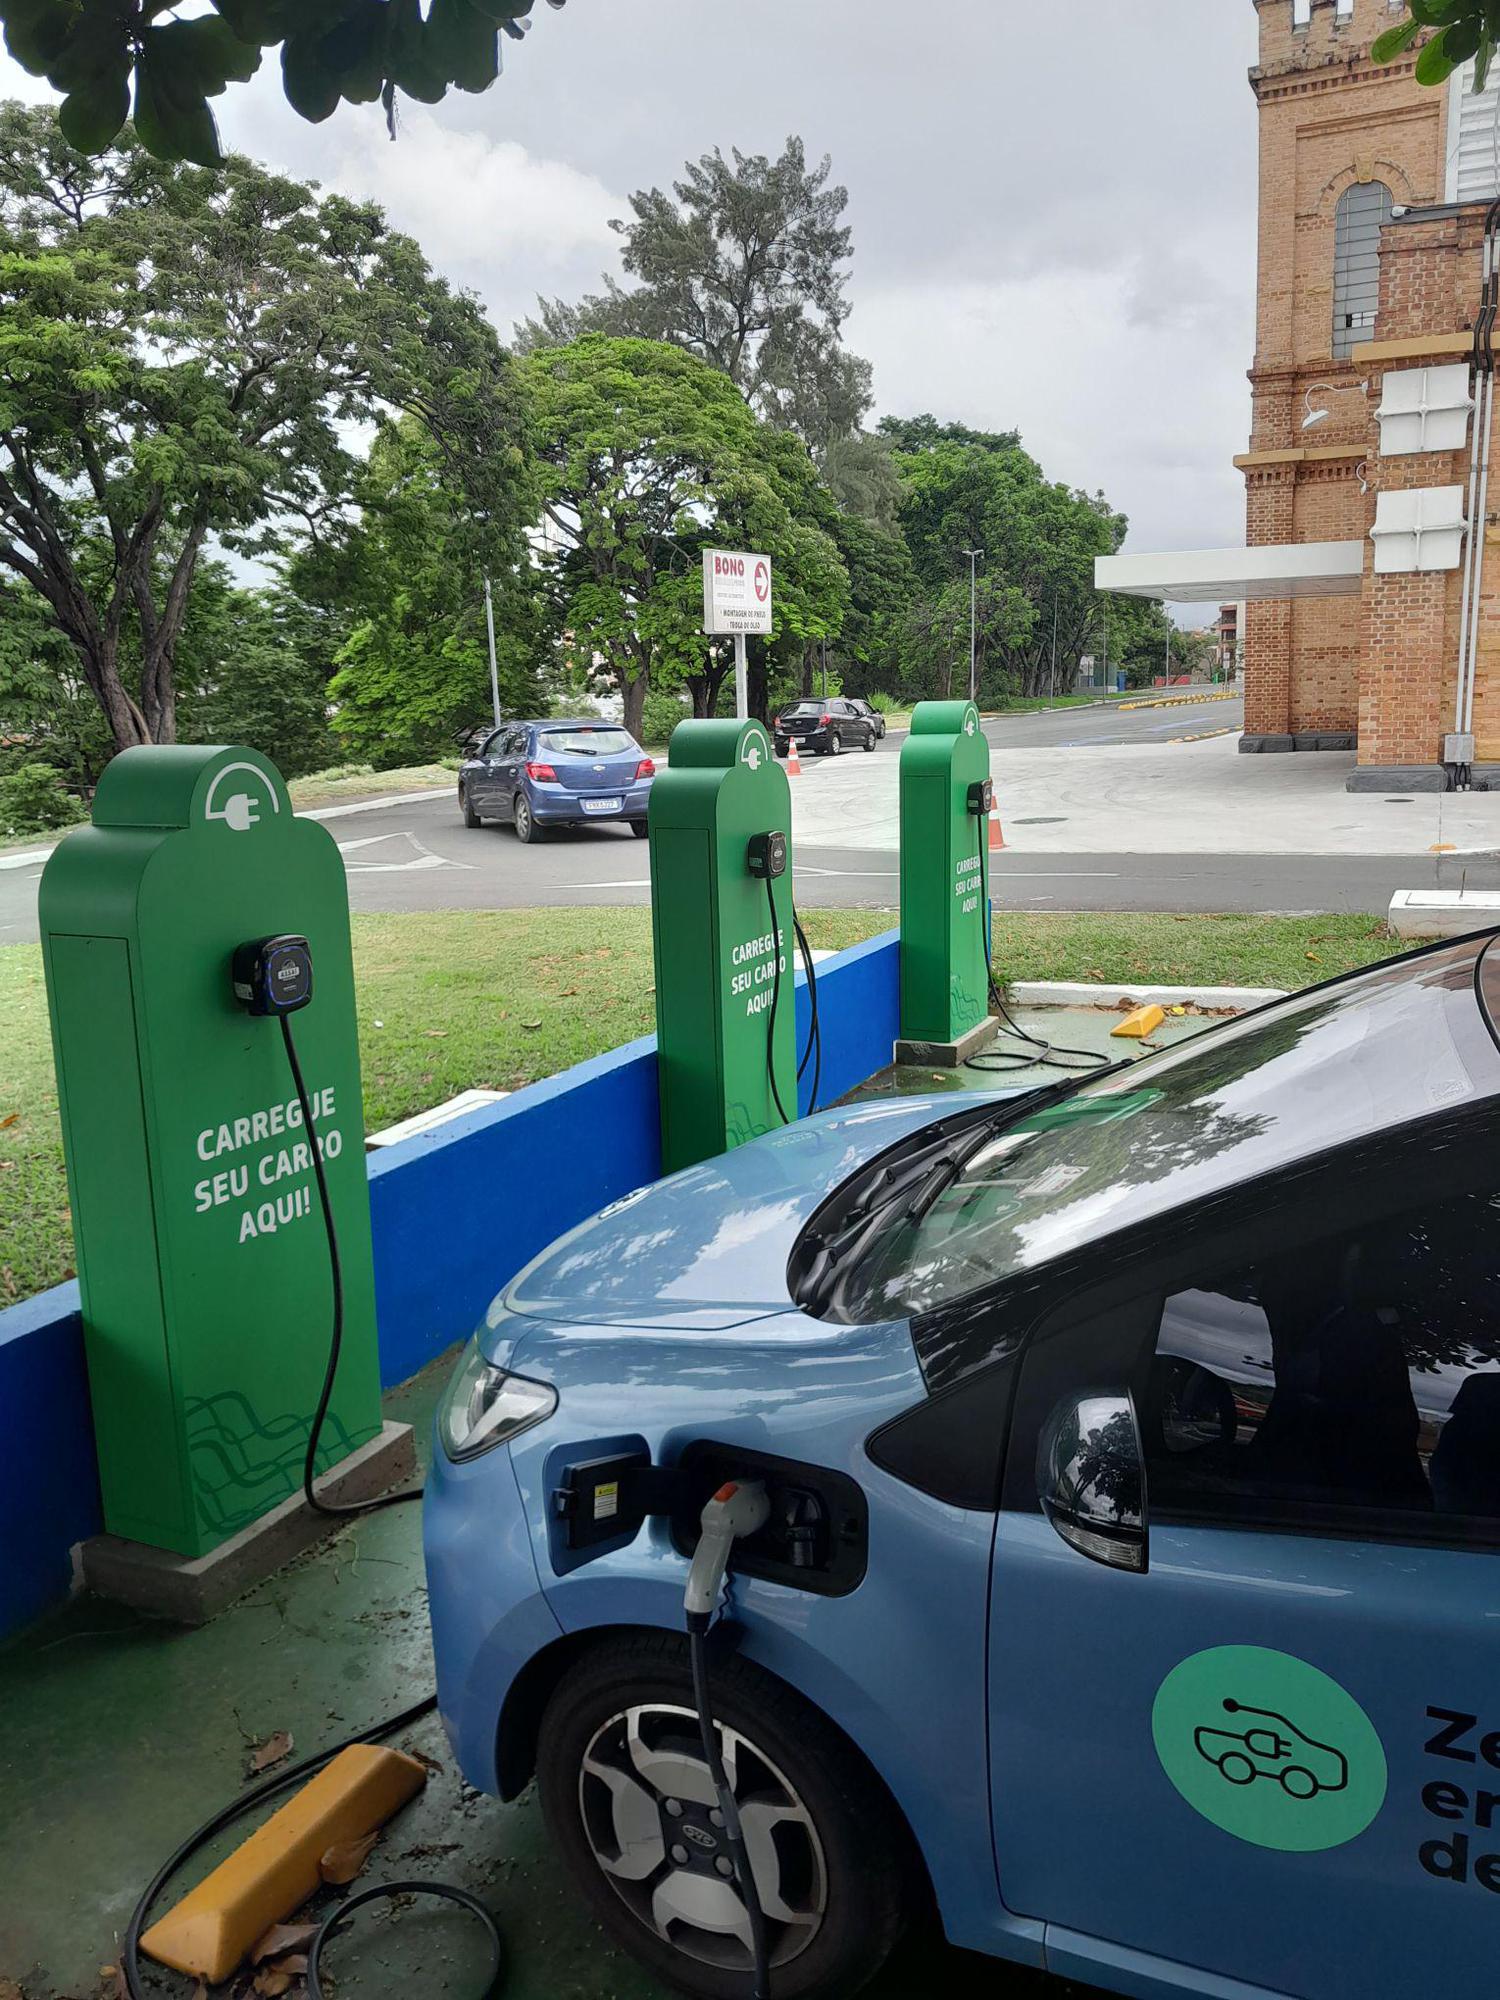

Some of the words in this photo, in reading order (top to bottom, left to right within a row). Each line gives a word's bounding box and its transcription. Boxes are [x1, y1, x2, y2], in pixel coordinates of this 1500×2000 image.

[715, 556, 745, 577] BONO
[955, 880, 966, 896] SEU
[967, 875, 982, 891] CARR
[731, 970, 751, 995] SEU
[746, 988, 774, 1016] AQUI!
[194, 1165, 249, 1213] SEU
[239, 1185, 311, 1243] AQUI!
